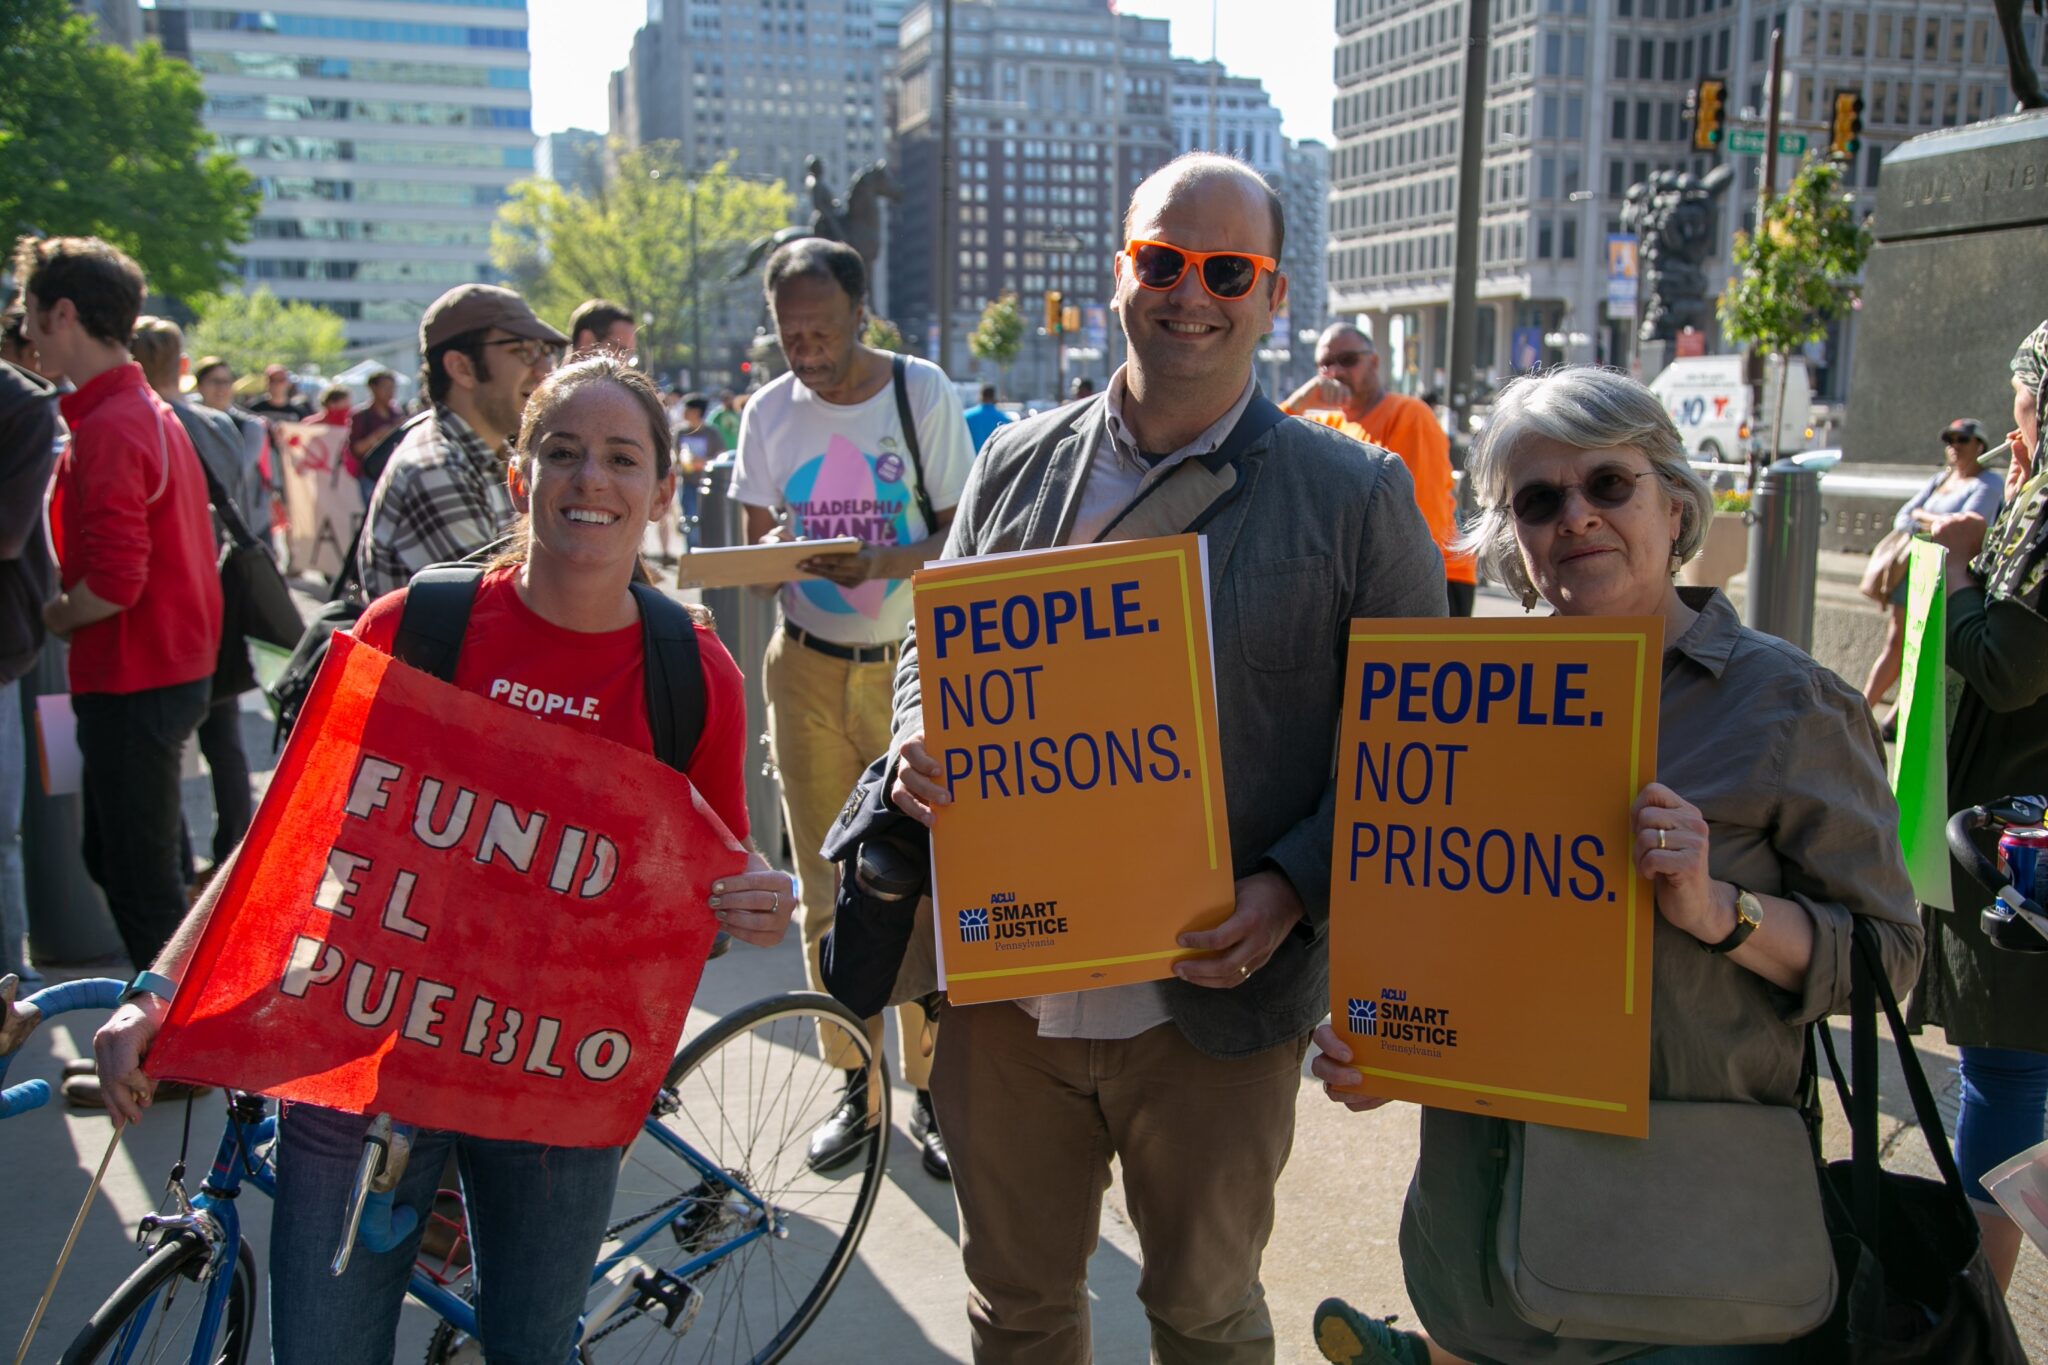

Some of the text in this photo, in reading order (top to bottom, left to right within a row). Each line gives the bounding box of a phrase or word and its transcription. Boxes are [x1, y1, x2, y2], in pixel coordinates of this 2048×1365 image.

[790, 499, 903, 516] HILADELPHIA
[934, 581, 1159, 658] PEOPLE.
[490, 678, 600, 721] PEOPLE.
[940, 666, 1043, 730] NOT
[1359, 662, 1604, 727] PEOPLE.
[945, 724, 1191, 803] PRISONS.
[1355, 742, 1468, 805] NOT
[344, 754, 619, 899] FUND
[1350, 822, 1617, 902] PRISONS.
[312, 847, 430, 941] EL
[991, 892, 1015, 904] ACLU
[992, 901, 1057, 922] SMART
[994, 917, 1068, 940] JUSTICE
[995, 938, 1055, 951] Pennsylvania
[279, 935, 632, 1081] PUEBLO
[1380, 1003, 1449, 1026] SMART
[1381, 988, 1407, 1001] ACLU
[1380, 1021, 1457, 1047] JUSTICE
[1381, 1040, 1442, 1058] Pennsylvania
